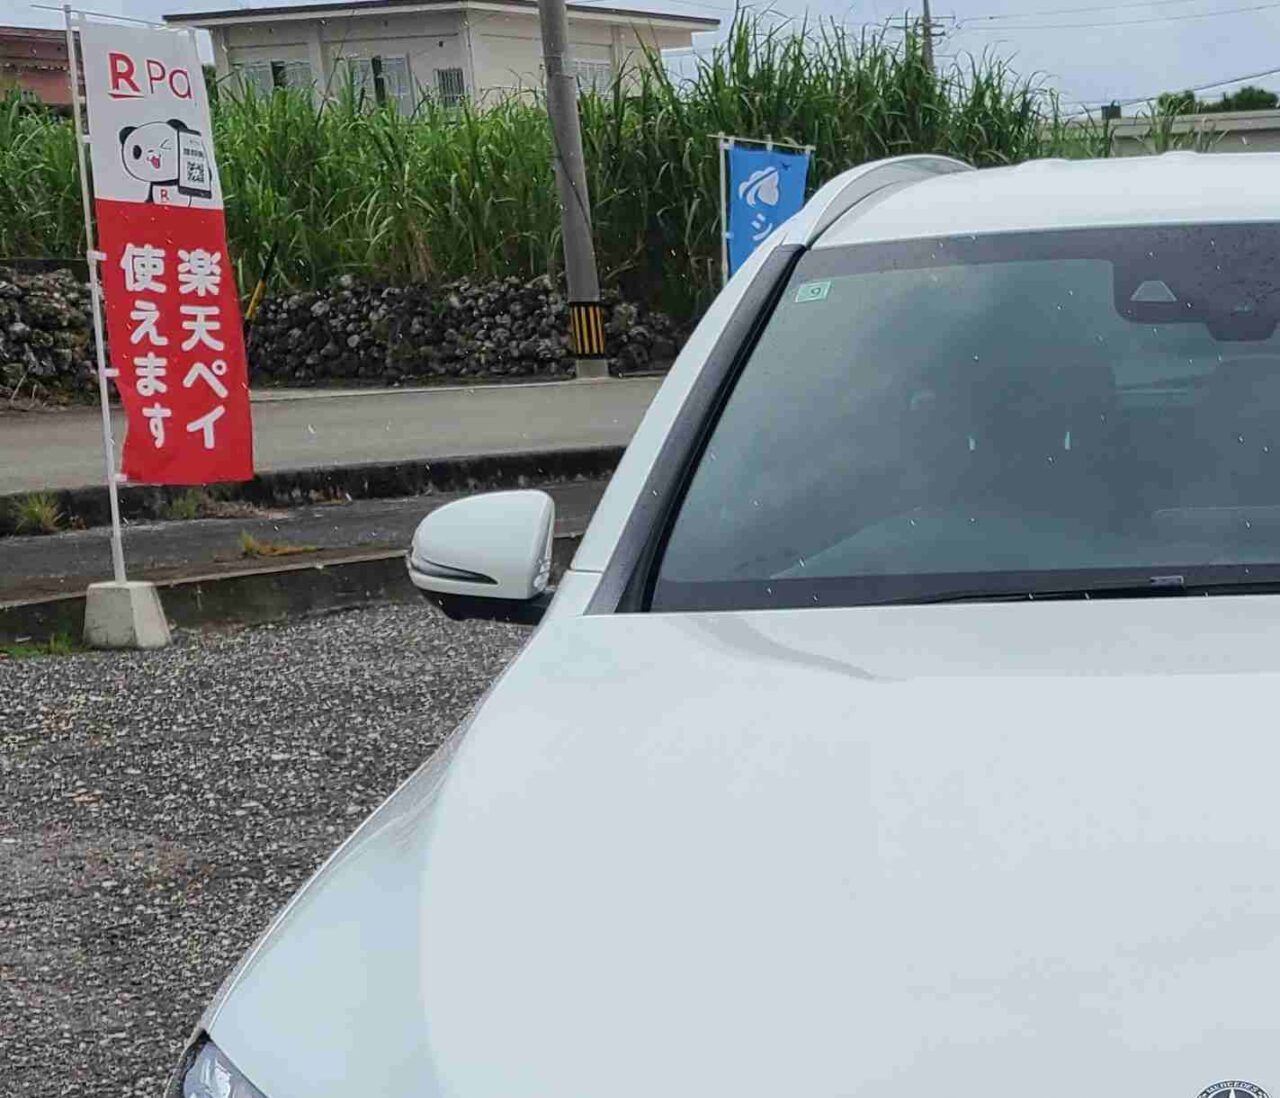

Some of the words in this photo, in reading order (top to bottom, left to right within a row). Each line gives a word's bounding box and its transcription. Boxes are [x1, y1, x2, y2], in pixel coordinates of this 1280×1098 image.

[146, 59, 193, 99] Pa
[120, 242, 173, 449] 使えます
[177, 248, 228, 450] 楽天ペイ
